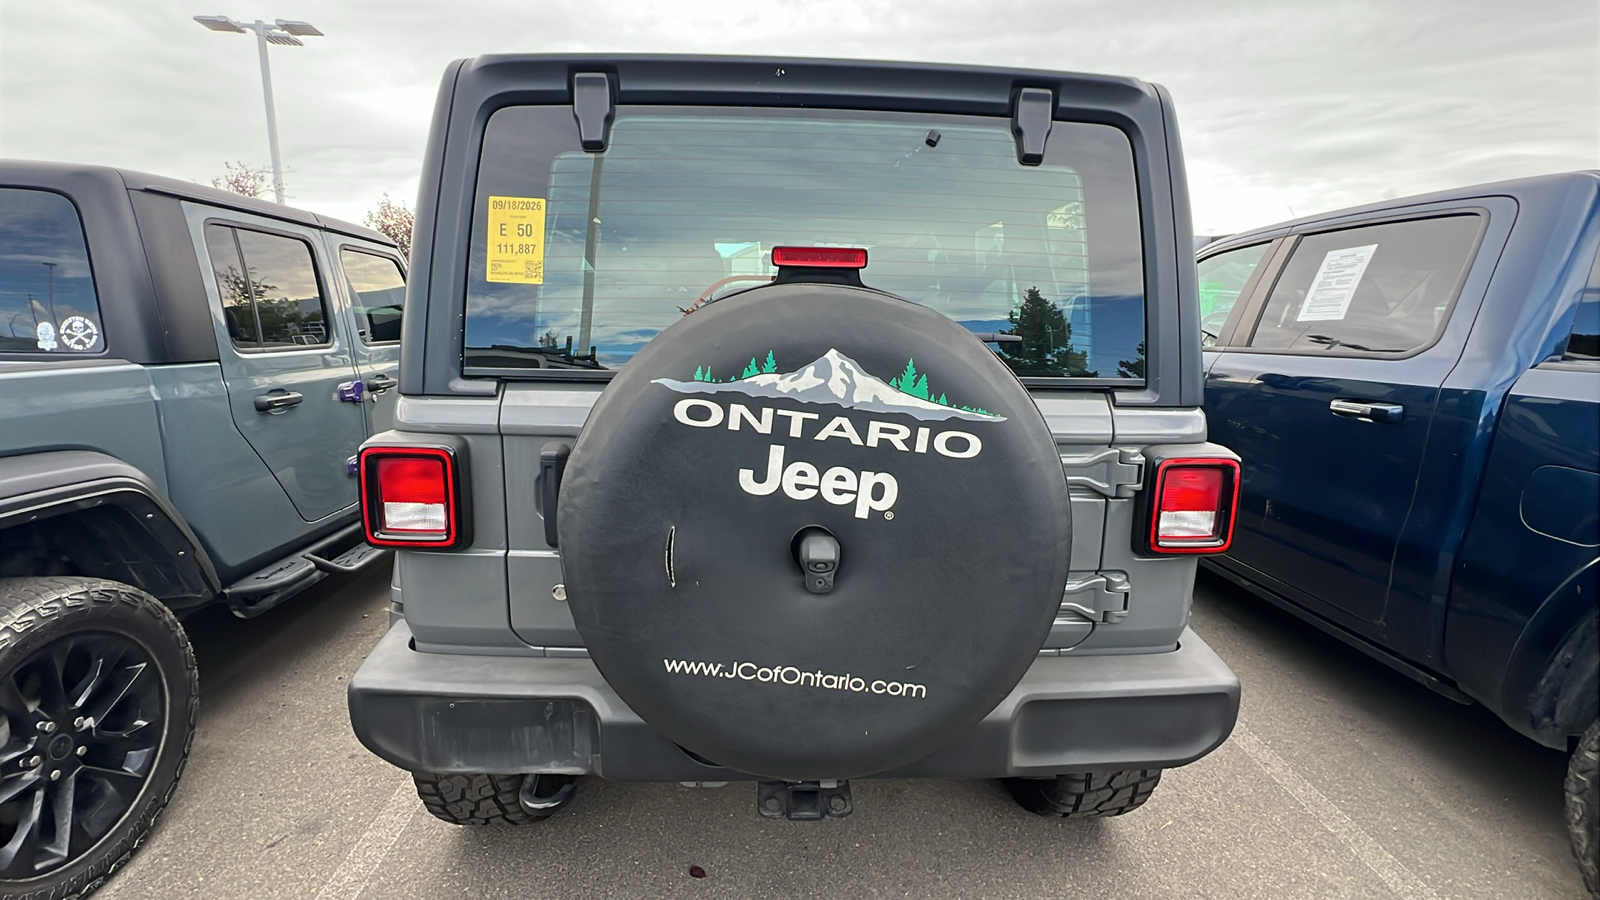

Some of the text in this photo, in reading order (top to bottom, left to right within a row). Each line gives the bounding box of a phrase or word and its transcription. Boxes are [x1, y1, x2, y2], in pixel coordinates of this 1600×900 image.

[492, 200, 542, 211] 09/18/2026
[499, 223, 533, 237] E 50
[497, 243, 536, 255] 111,887
[673, 398, 983, 459] ONTARIO
[738, 444, 899, 520] Jeep
[663, 658, 927, 698] www.JCofOntario.com
